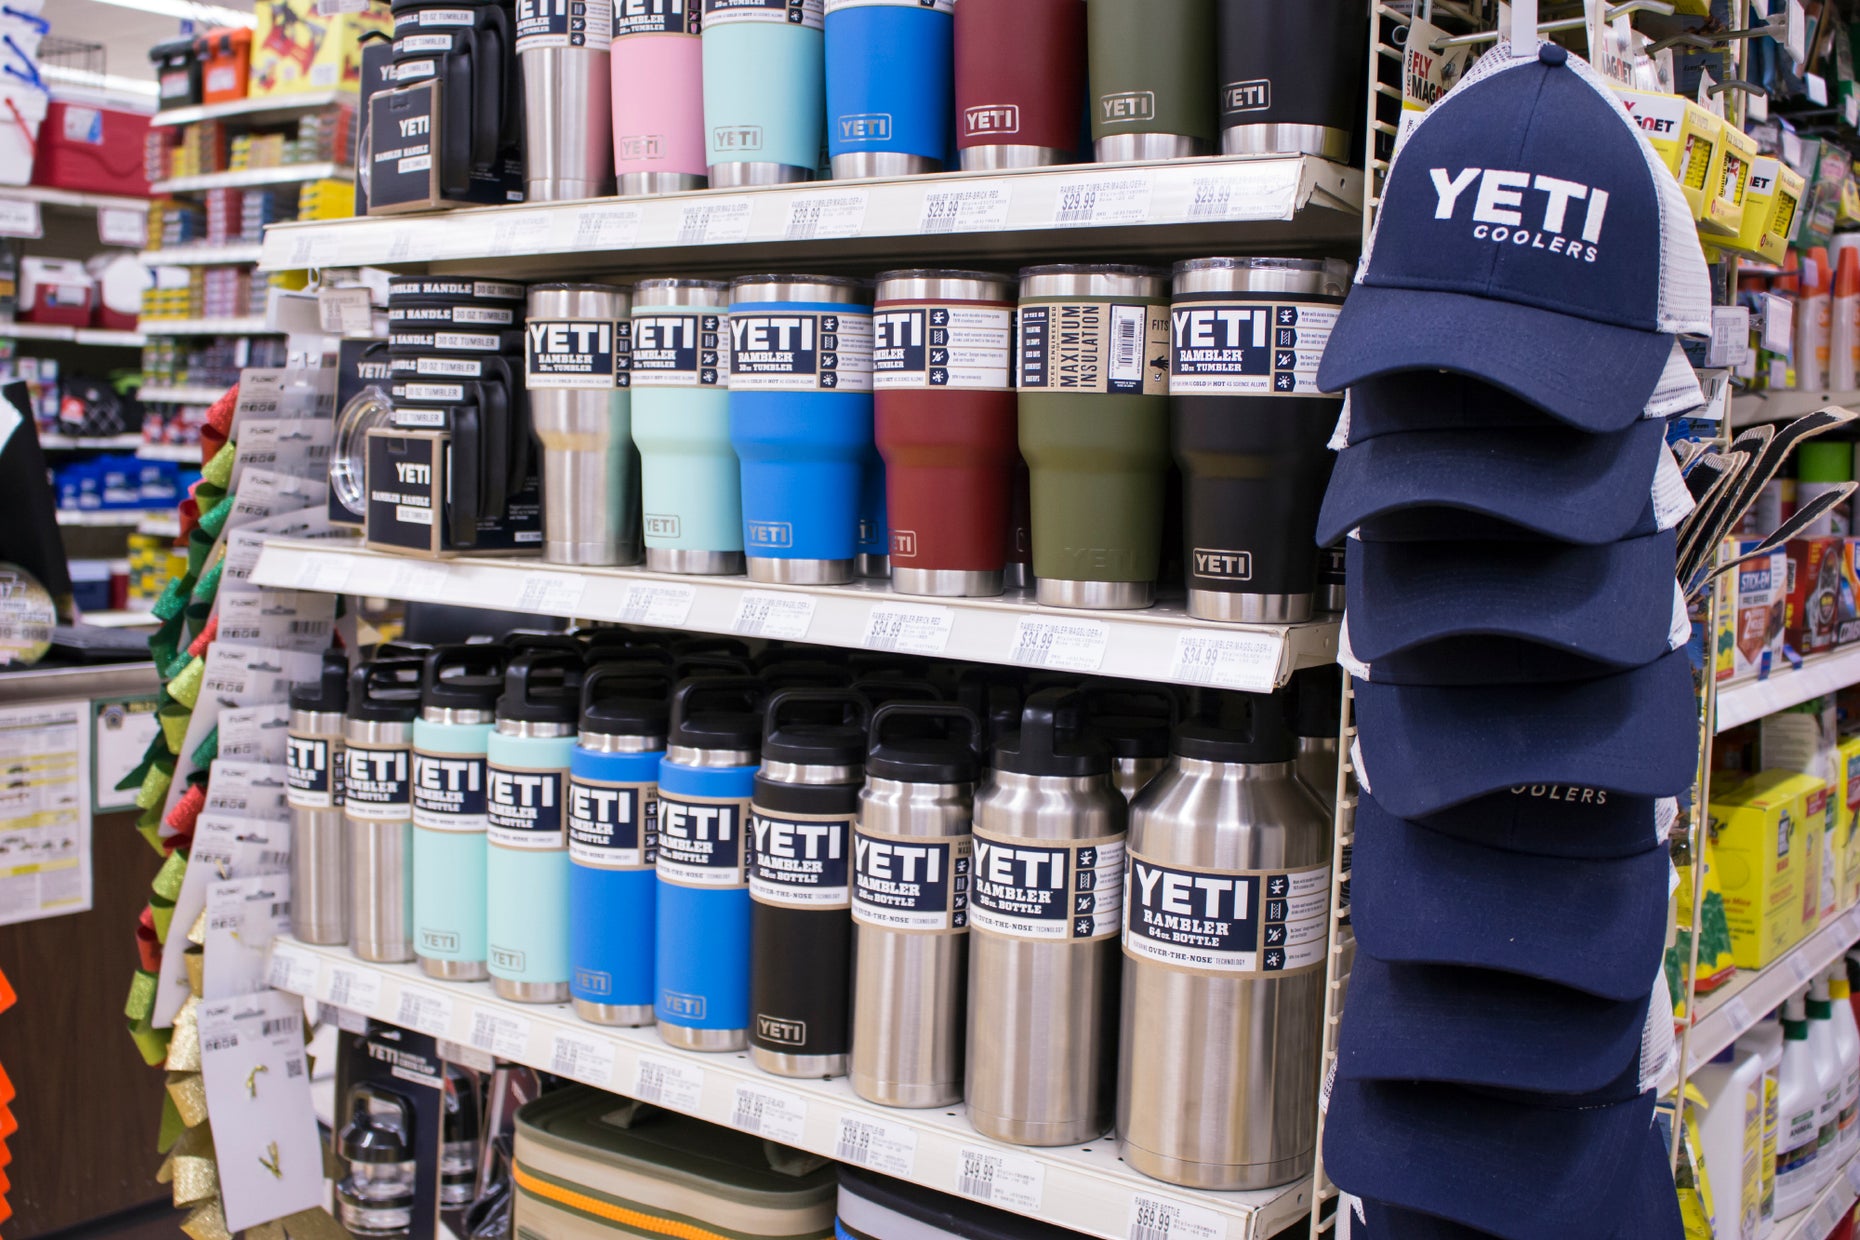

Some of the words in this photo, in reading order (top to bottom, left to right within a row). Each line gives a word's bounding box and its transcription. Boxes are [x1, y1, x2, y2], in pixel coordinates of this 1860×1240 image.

[438, 12, 469, 20] TUMBLER
[619, 16, 665, 27] RAMBLER
[632, 24, 665, 32] TUMBLER
[1412, 51, 1432, 80] FLY
[1224, 85, 1264, 108] YETI
[1102, 98, 1148, 118] YETI
[400, 115, 430, 138] YETI
[842, 119, 886, 136] YETI
[967, 110, 1012, 130] YETI
[623, 140, 658, 156] YETI
[716, 131, 758, 147] YETI
[928, 201, 958, 218] $29.99
[1062, 192, 1096, 210] $29.99
[1429, 167, 1608, 244] YETI
[792, 208, 820, 224] $29.99
[1472, 224, 1598, 262] COOLERS
[422, 284, 472, 294] HANDLE
[407, 310, 451, 320] HANDLE
[466, 312, 476, 320] OZ
[478, 312, 510, 321] TUMBLER
[730, 318, 813, 352] YETI
[1152, 320, 1168, 332] FITS
[1172, 310, 1266, 348] YETI
[396, 335, 434, 344] HANDLE
[437, 336, 446, 344] 30
[448, 336, 458, 346] OZ
[460, 336, 495, 347] TUMBLER
[530, 323, 610, 354] YETI
[1060, 306, 1080, 387] MAXIMUM
[1080, 306, 1099, 387] INSULATION
[538, 354, 592, 364] RAMBLER
[738, 352, 793, 362] RAMBLER
[1180, 350, 1242, 362] RAMBLER
[357, 362, 385, 379] YETI
[440, 362, 476, 372] TUMBLER
[554, 364, 592, 372] TUMBLER
[753, 364, 792, 372] TUMBLER
[1197, 363, 1242, 372] TUMBLER
[424, 388, 458, 397] TUMBLER
[396, 462, 430, 484] YETI
[646, 519, 676, 534] YETI
[750, 526, 786, 542] YETI
[1196, 553, 1245, 574] YETI
[872, 620, 902, 638] $34.99
[1020, 631, 1053, 650] $34.99
[1182, 646, 1218, 666] $34.99
[657, 798, 731, 841] YETI
[752, 816, 842, 860] YETI
[672, 850, 709, 864] BOTTLE
[758, 852, 823, 873] RAMBLER
[854, 835, 940, 882] YETI
[973, 838, 1064, 889] YETI
[777, 869, 818, 884] BOTTLE
[857, 872, 920, 896] RAMBLER
[874, 893, 916, 907] BOTTLE
[976, 878, 1052, 904] RAMBLER
[1136, 864, 1249, 920] YETI
[998, 900, 1042, 914] BOTTLE
[978, 916, 1033, 932] OVER-THE-NOSE
[1143, 909, 1230, 936] RAMBLER
[422, 932, 455, 948] YETI
[1172, 932, 1220, 946] BOTTLE
[492, 948, 522, 968] YETI
[1148, 946, 1213, 964] OVER-THE-NOSE
[1216, 958, 1245, 966] TECHNOLOGY
[575, 972, 607, 991] YETI
[665, 993, 701, 1015] YETI
[760, 1020, 800, 1041] YETI
[368, 1041, 398, 1065] YETI
[842, 1127, 870, 1149] $39.99
[964, 1160, 994, 1182] $49.99
[1136, 1207, 1170, 1232] $69.99
